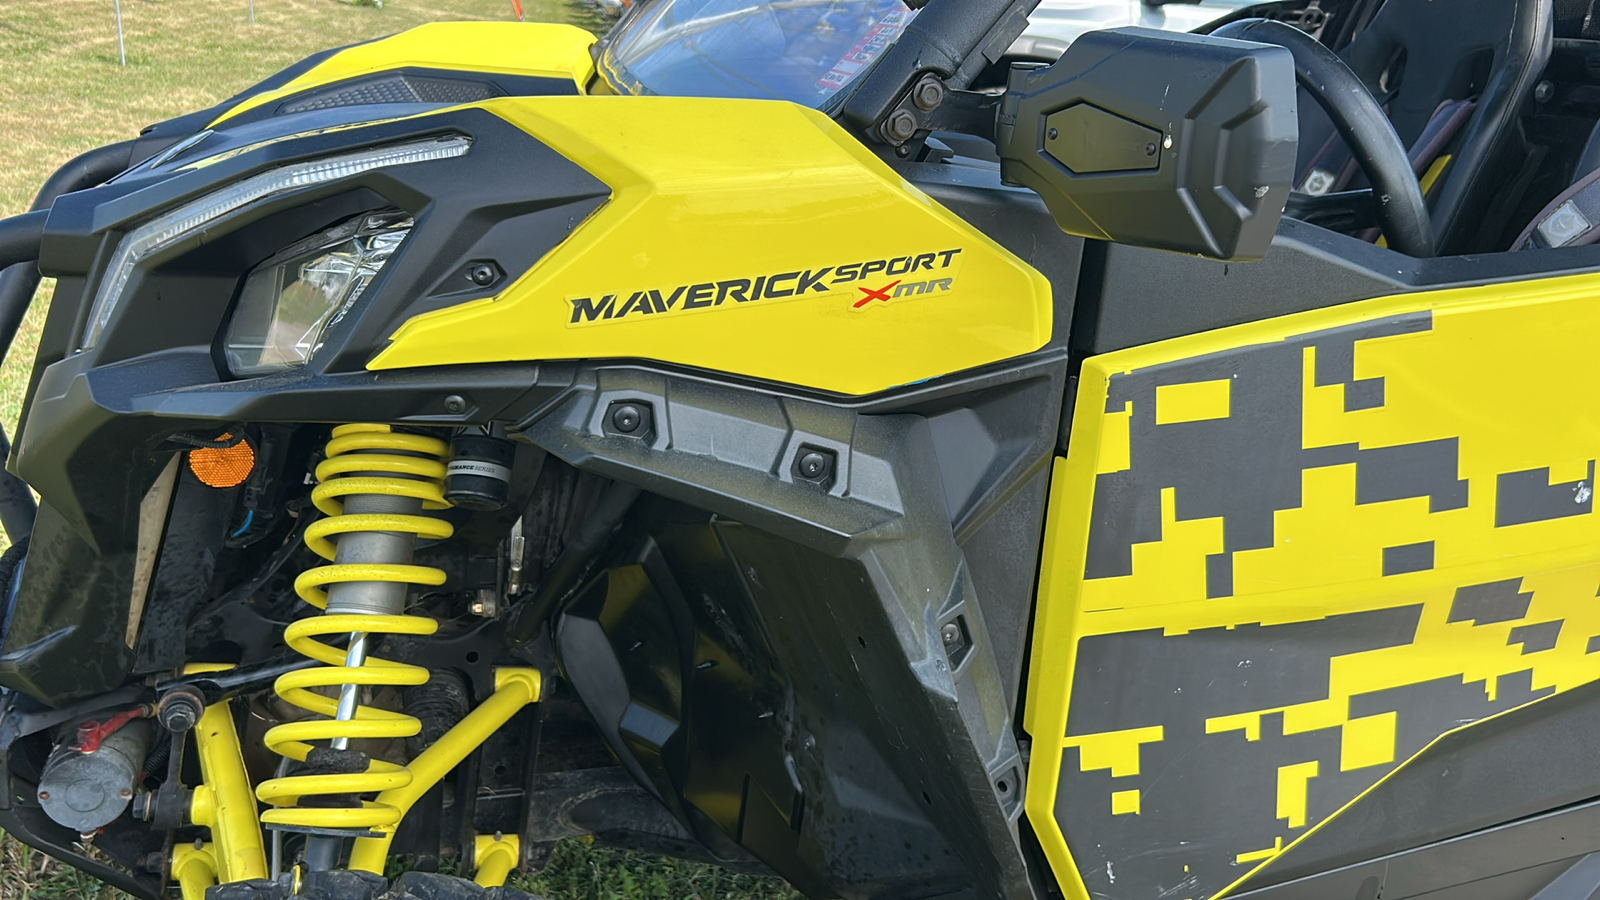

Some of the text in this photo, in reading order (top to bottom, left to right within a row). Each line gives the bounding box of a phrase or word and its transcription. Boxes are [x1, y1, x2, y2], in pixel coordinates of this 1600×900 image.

[570, 247, 962, 324] MAVERICK SPORT
[475, 465, 495, 473] SERIES
